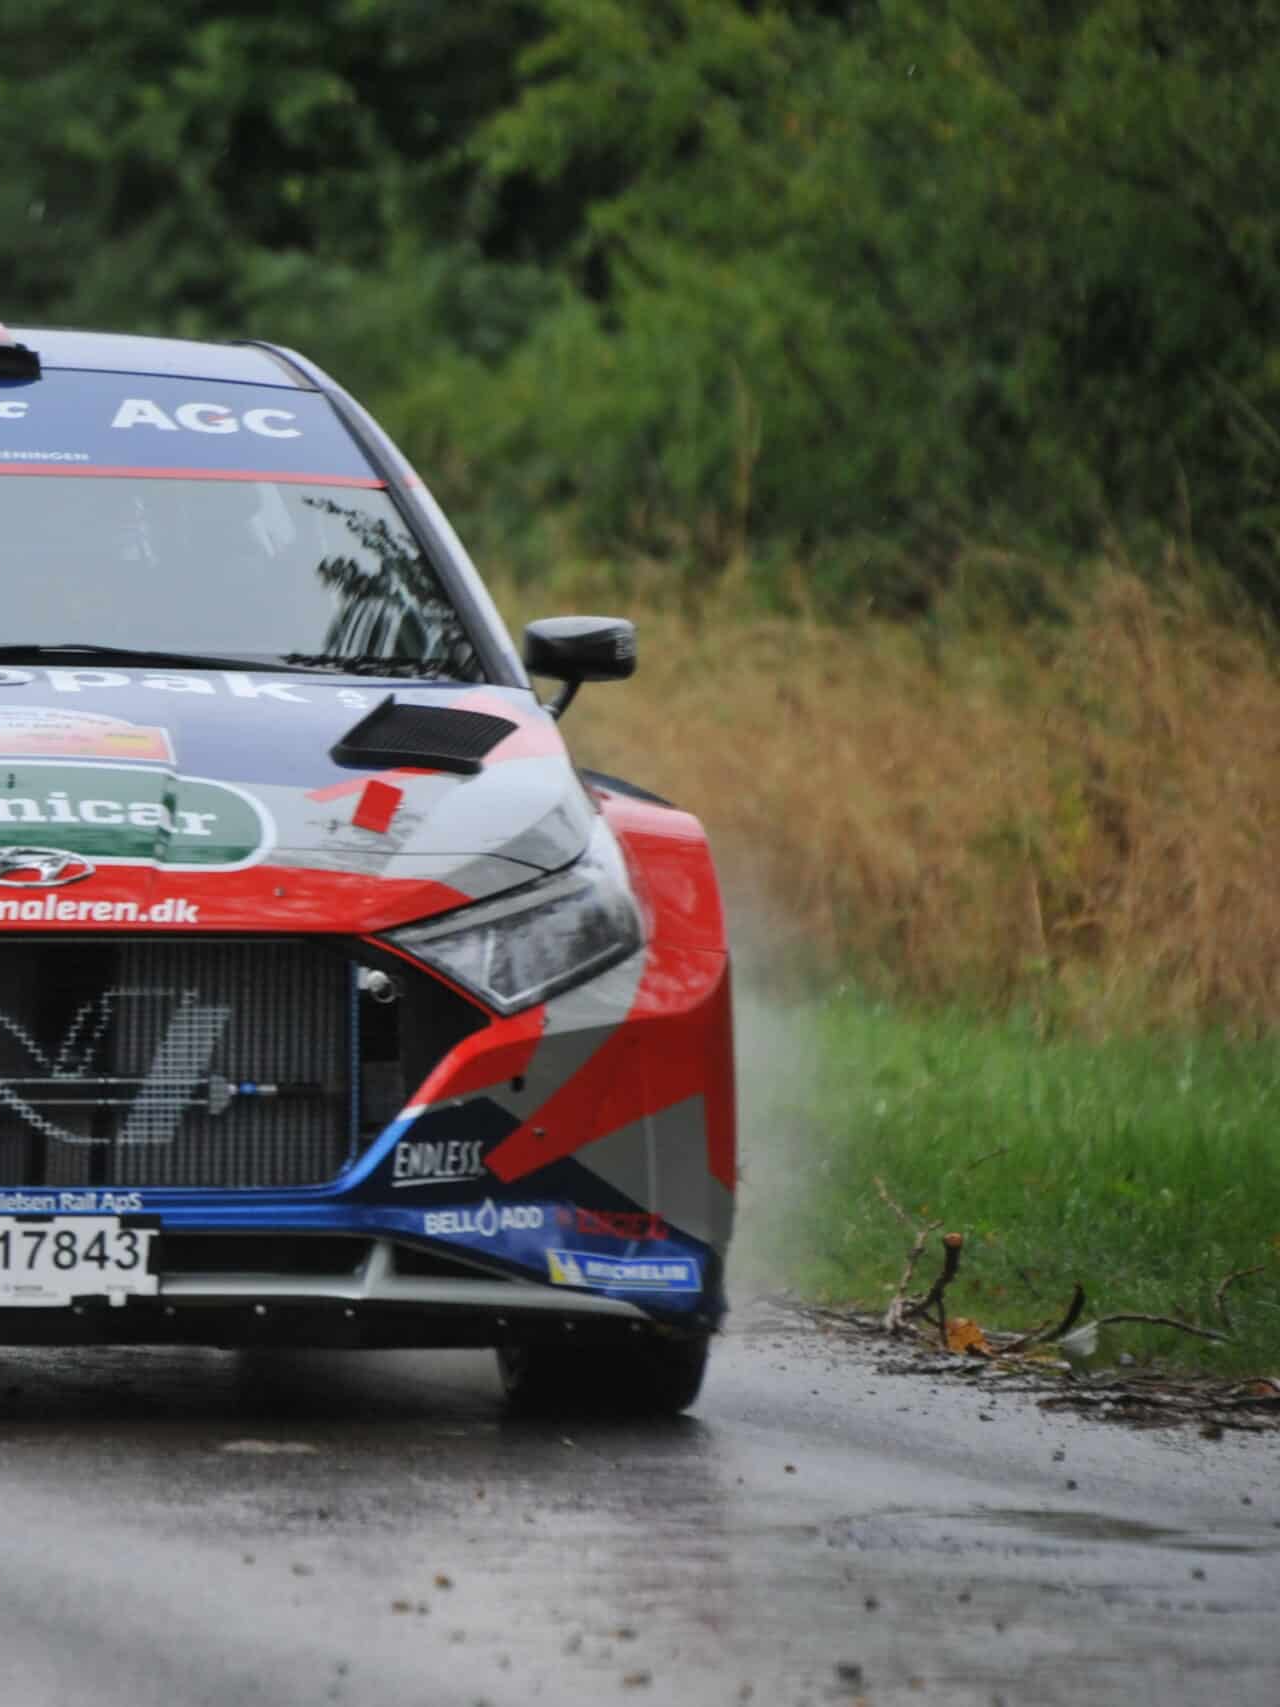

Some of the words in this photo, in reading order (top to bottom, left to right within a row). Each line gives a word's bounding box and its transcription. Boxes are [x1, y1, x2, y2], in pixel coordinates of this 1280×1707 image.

[111, 399, 303, 438] AGC
[393, 1141, 484, 1179] ENDLESS
[60, 1193, 97, 1211] Rail
[101, 1193, 143, 1213] ApS
[424, 1210, 478, 1235] BELL
